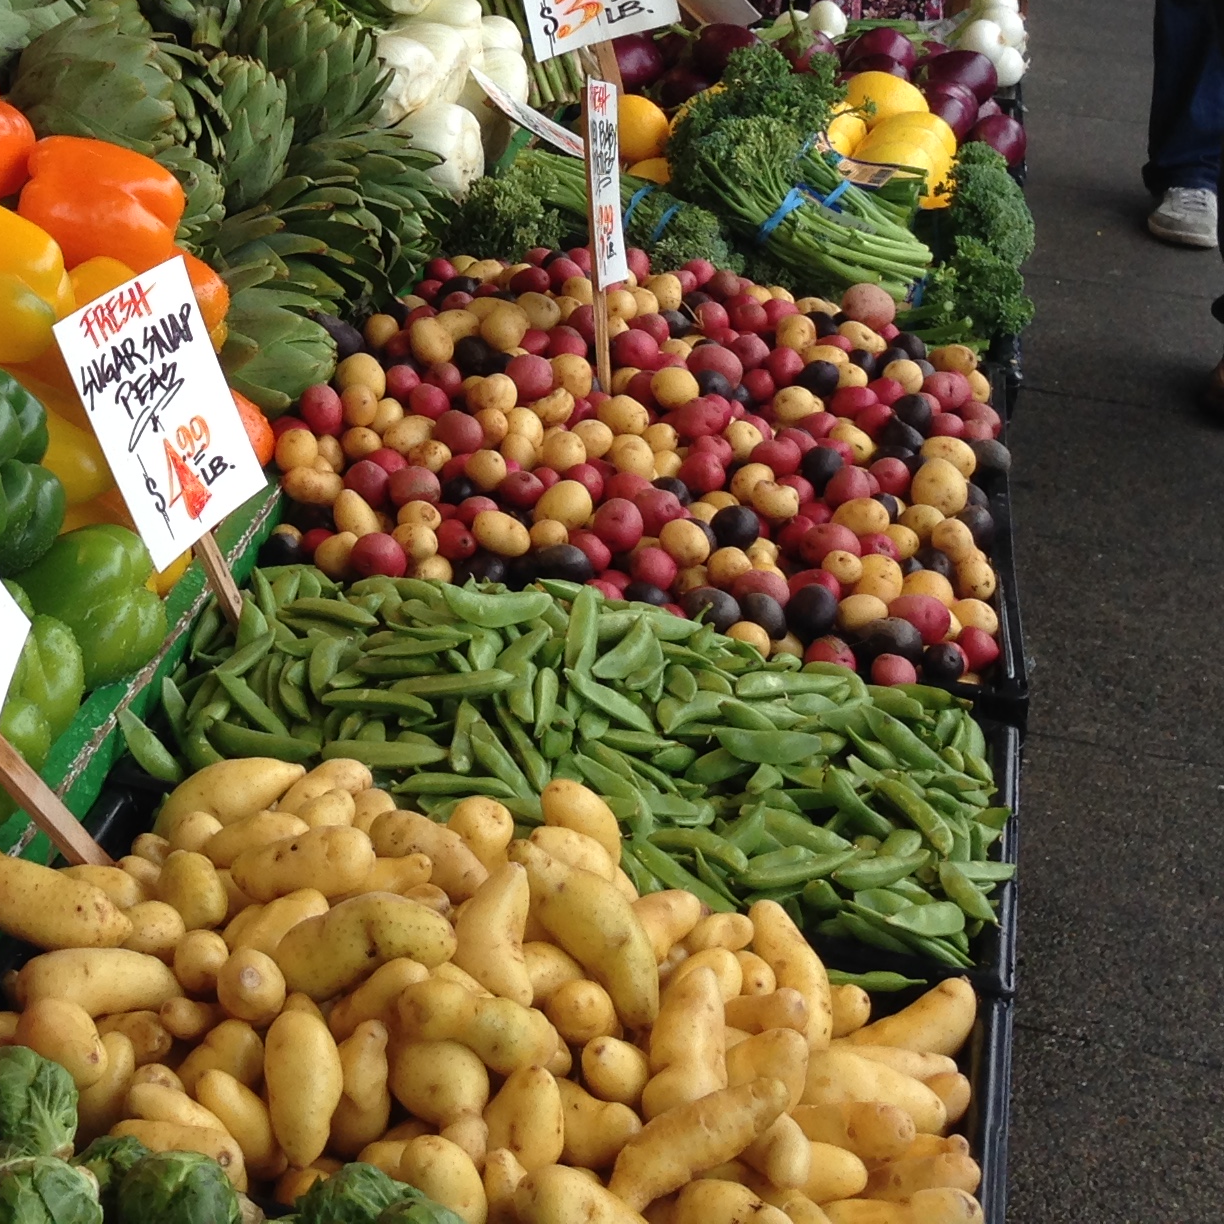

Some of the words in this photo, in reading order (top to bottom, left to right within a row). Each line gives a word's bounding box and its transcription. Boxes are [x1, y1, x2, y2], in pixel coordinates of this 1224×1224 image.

[79, 281, 156, 348] FRESH
[80, 337, 144, 411] SUGAR
[143, 303, 192, 364] SNAP
[115, 362, 177, 419] PEAS
